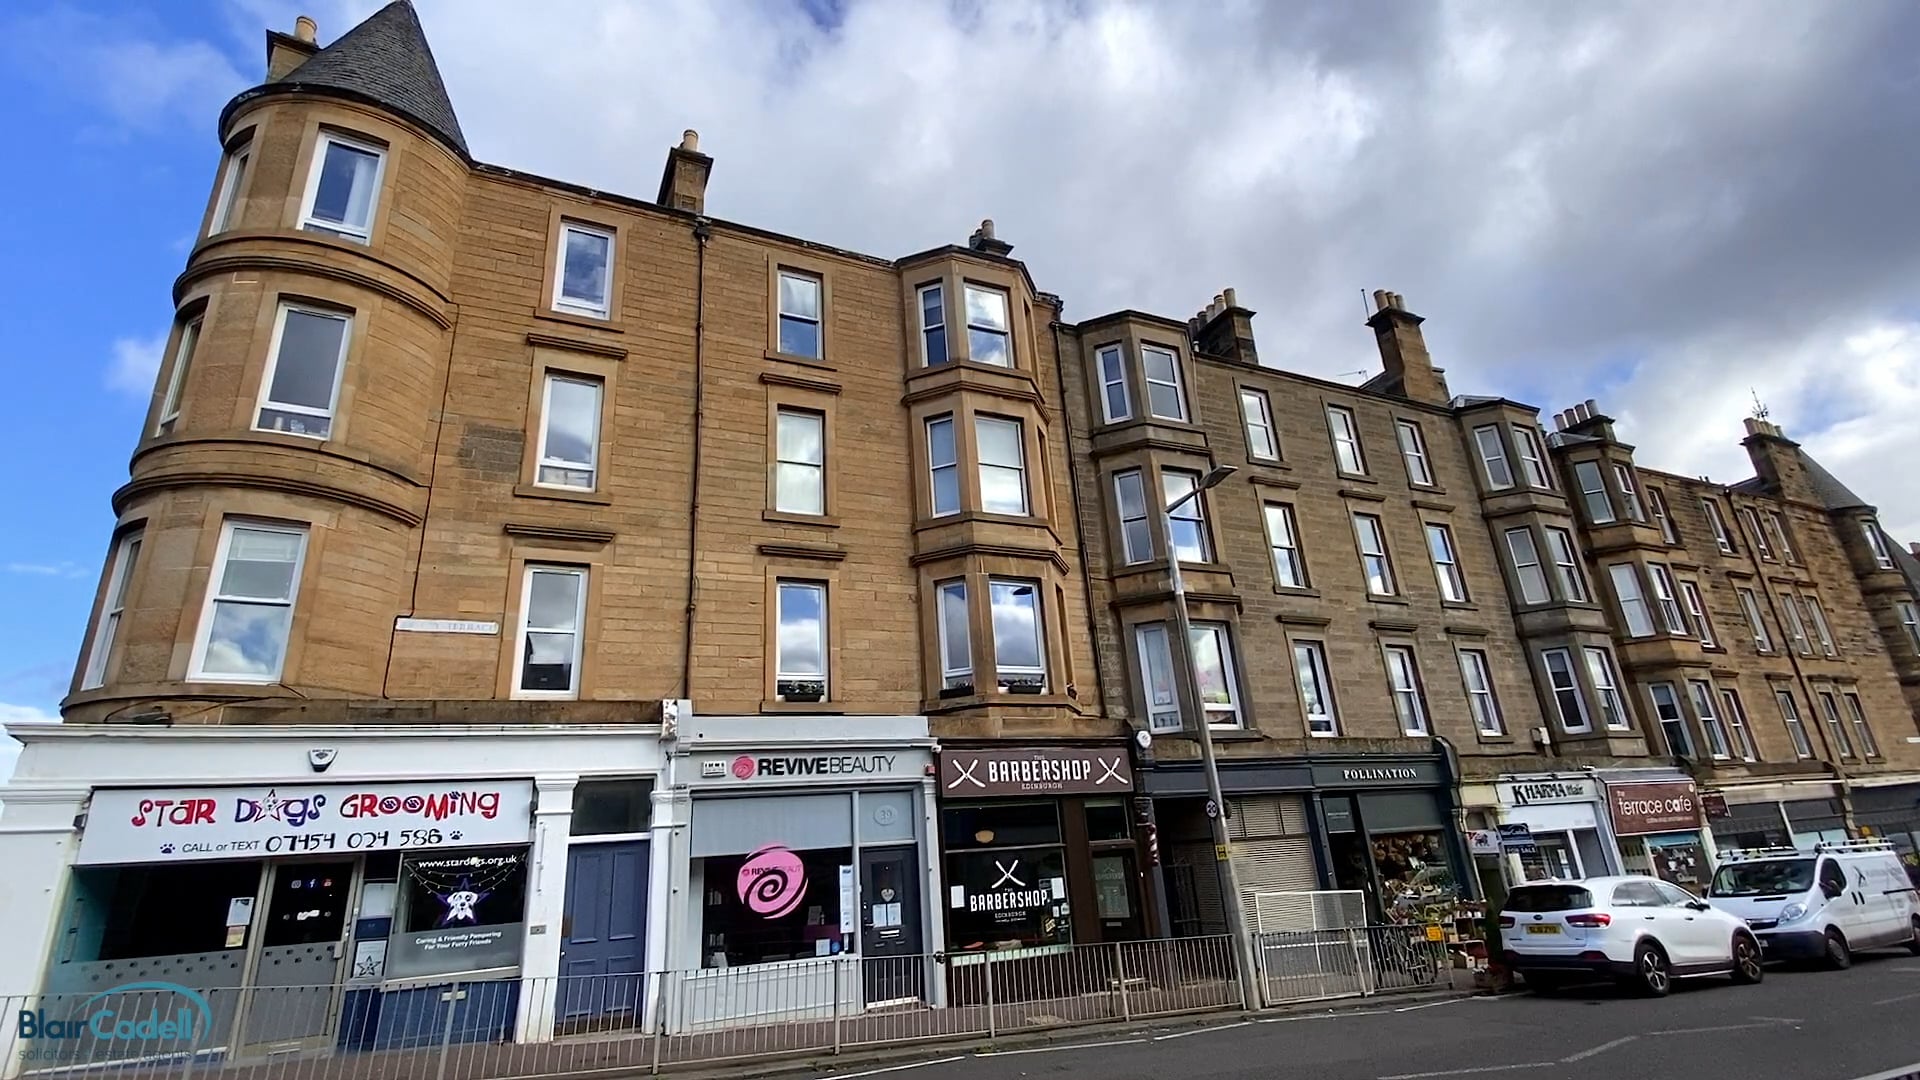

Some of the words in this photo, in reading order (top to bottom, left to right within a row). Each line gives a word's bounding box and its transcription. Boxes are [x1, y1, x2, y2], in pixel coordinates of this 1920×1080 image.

[988, 760, 1091, 782] BARBERSHOP
[1343, 768, 1417, 780] POLLINATION
[1512, 784, 1567, 804] KHARMA
[1619, 798, 1662, 815] terrace
[182, 843, 213, 853] CALL
[215, 843, 228, 851] or
[230, 841, 260, 851] TEXT
[265, 833, 336, 853] 07454
[347, 831, 389, 849] 024
[400, 829, 443, 847] 586
[418, 855, 517, 868] www.stardogs.org.uk
